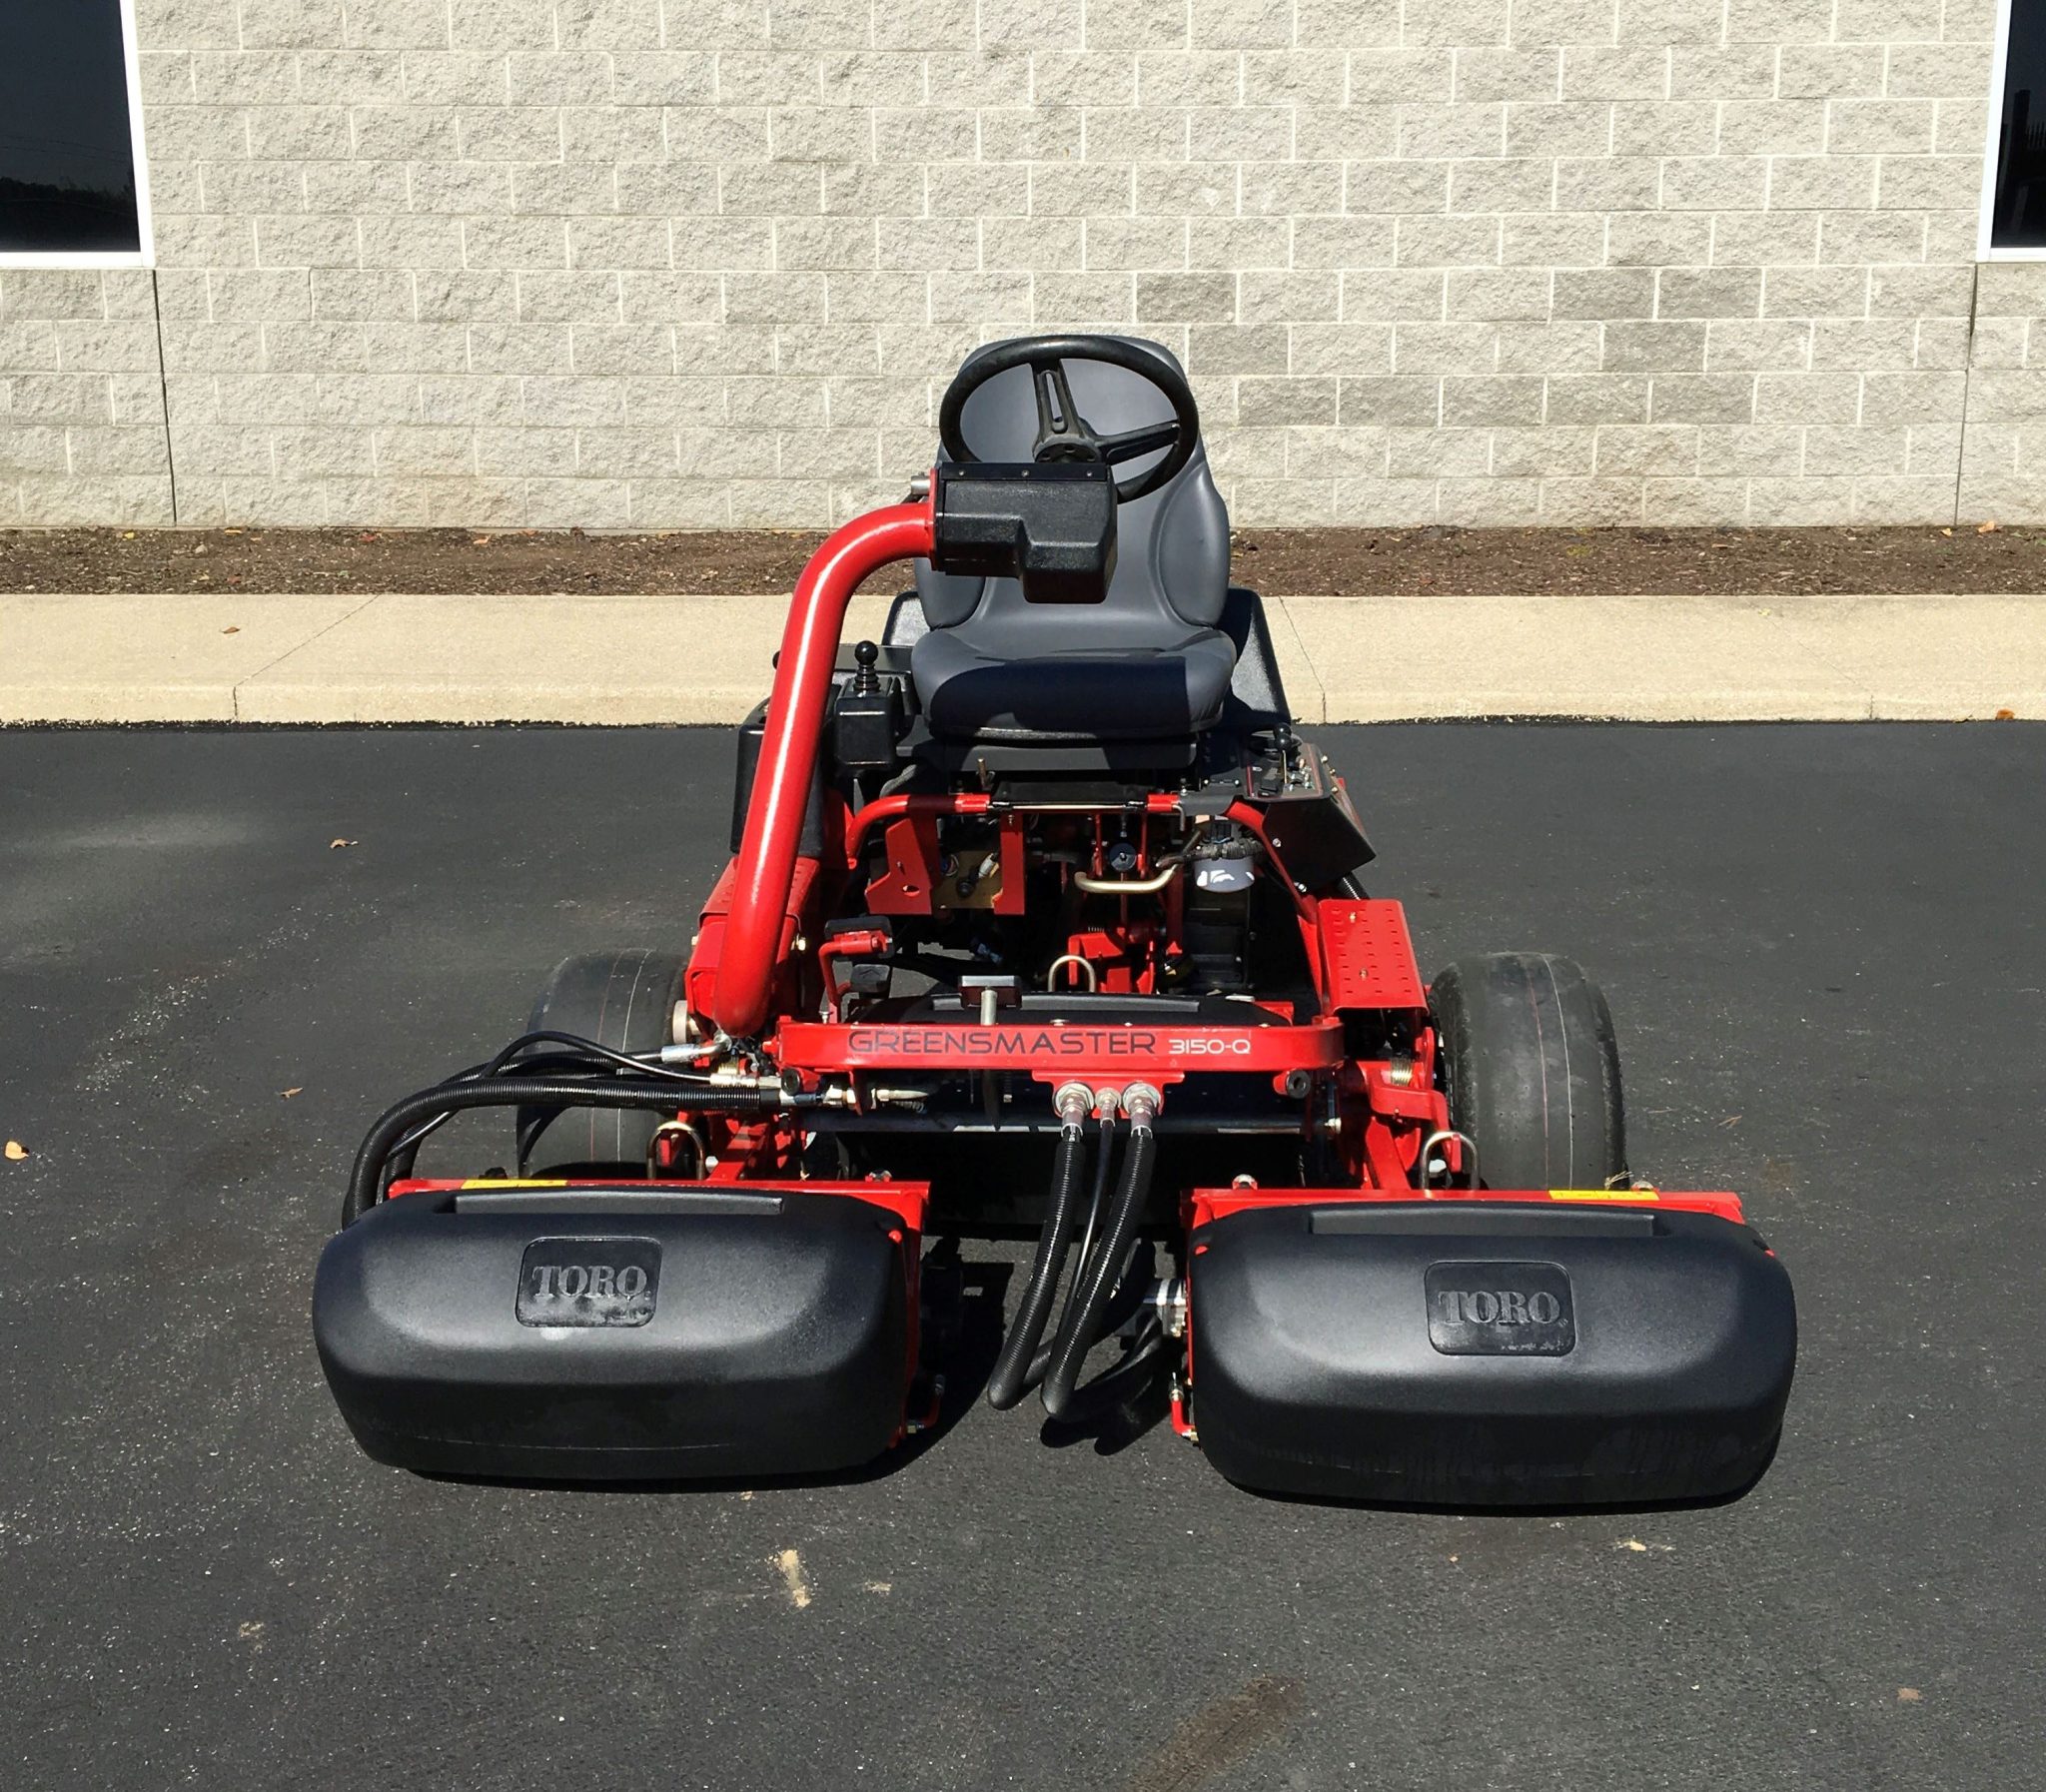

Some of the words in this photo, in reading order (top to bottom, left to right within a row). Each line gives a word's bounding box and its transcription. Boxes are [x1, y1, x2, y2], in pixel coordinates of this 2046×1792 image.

[848, 1030, 1155, 1055] GREENSMASTER
[1168, 1039, 1251, 1055] 3150-Q
[531, 1265, 647, 1299] TORO
[1438, 1291, 1560, 1326] TORO
